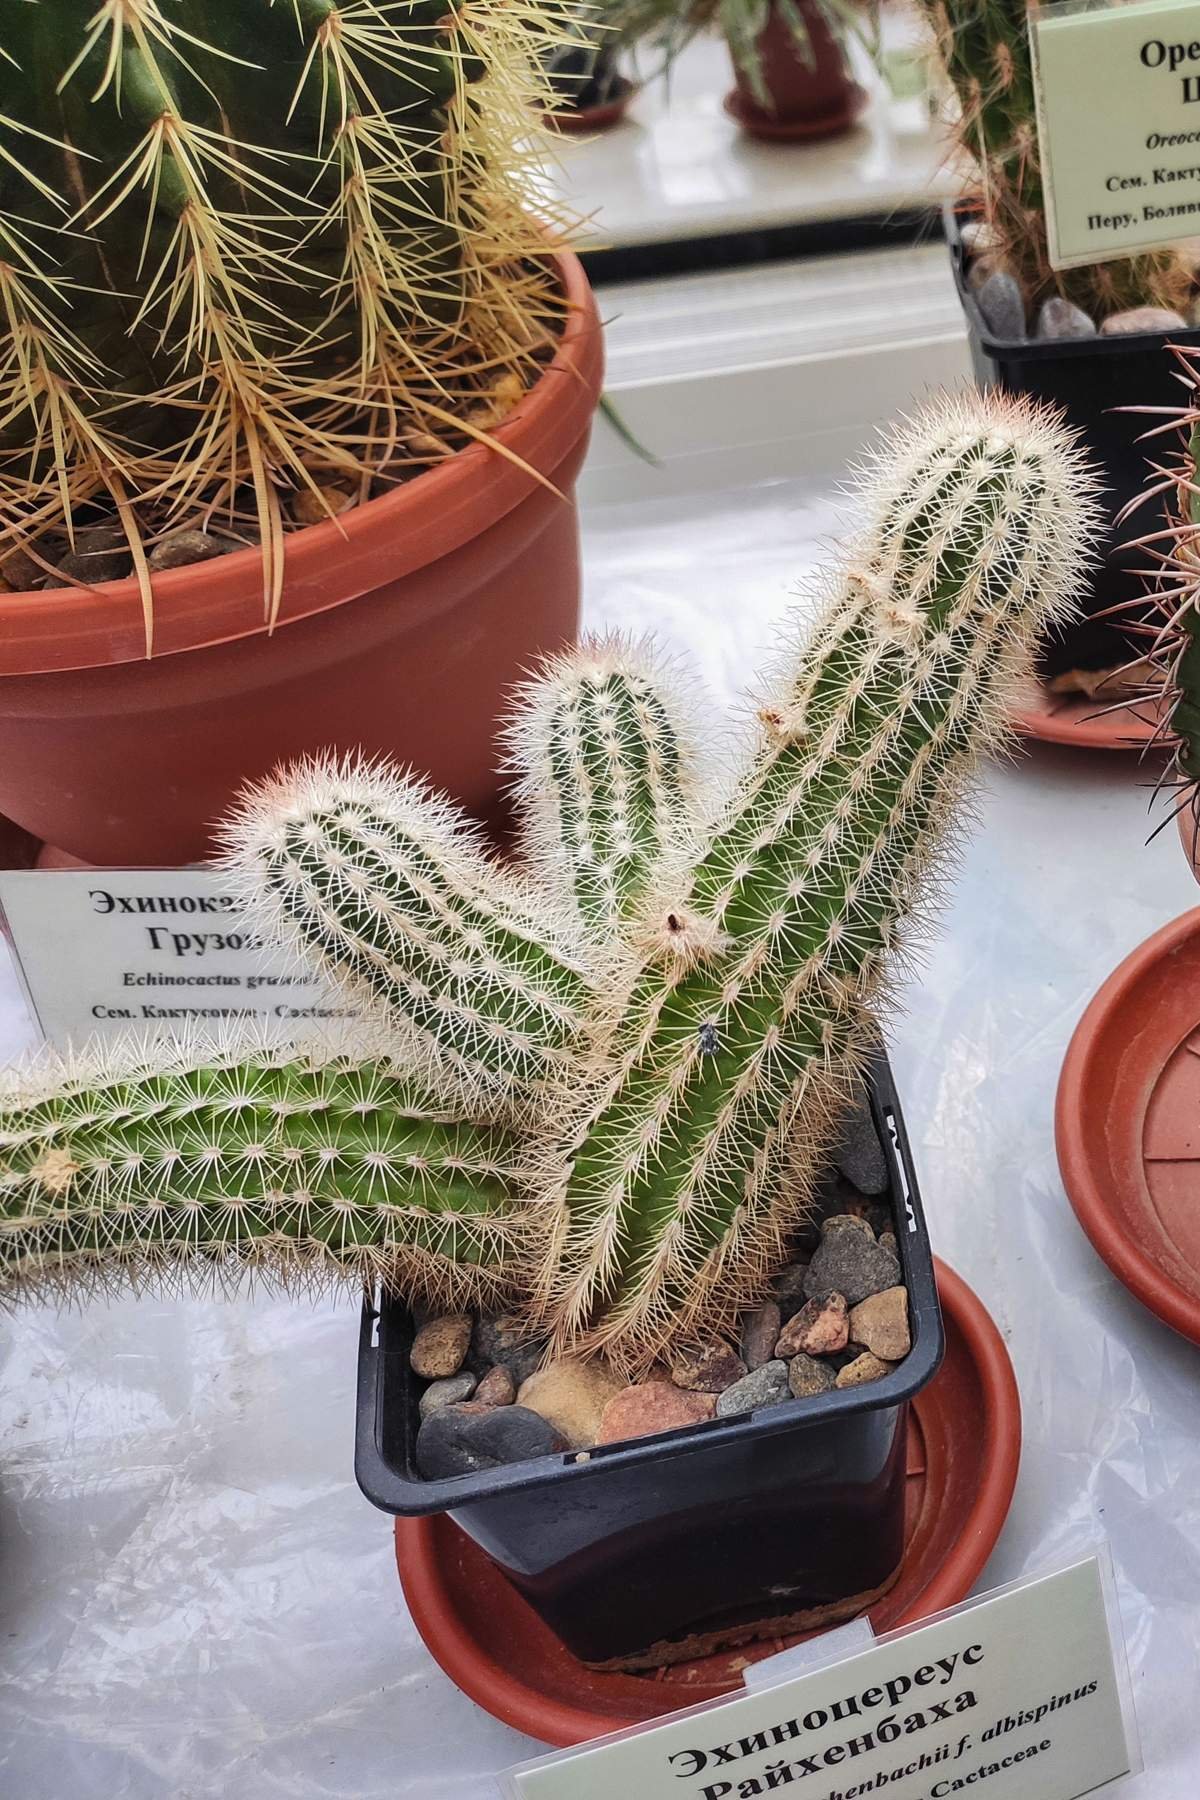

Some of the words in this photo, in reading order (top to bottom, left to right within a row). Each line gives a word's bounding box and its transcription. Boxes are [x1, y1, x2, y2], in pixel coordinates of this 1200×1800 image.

[1106, 176, 1147, 192] Сем.
[1087, 213, 1138, 230] Перу,
[122, 971, 240, 986] Echinocactus
[92, 1005, 137, 1018] Сем.
[668, 1644, 984, 1778] Эхиноцереус
[953, 1735, 972, 1759] f.
[981, 1680, 1098, 1743] albispinus
[698, 1690, 978, 1800] Райхенбаха
[931, 1739, 1051, 1798] Cactaceae
